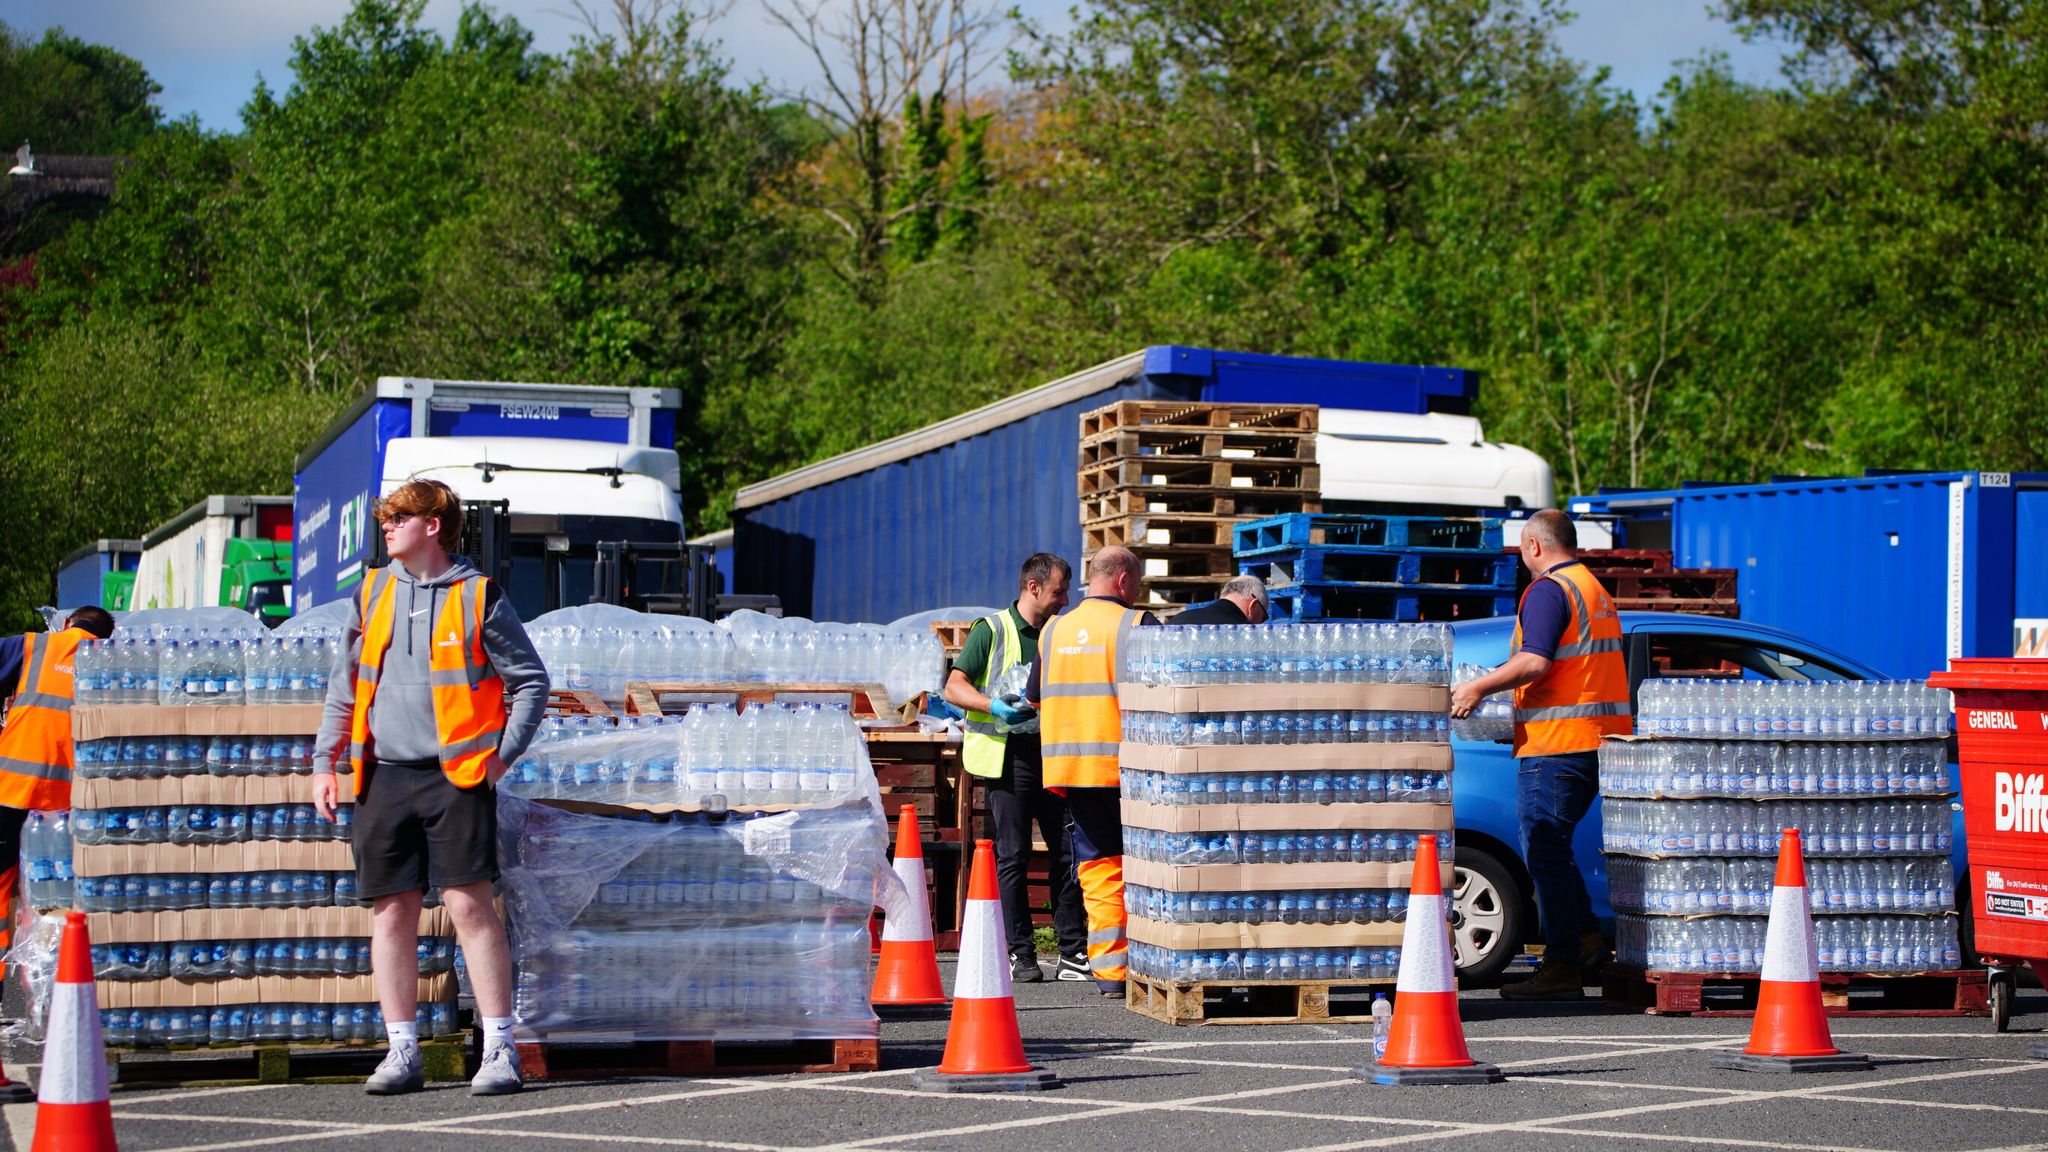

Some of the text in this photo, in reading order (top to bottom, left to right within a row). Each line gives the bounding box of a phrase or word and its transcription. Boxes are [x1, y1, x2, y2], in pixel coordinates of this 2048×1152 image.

[500, 404, 560, 421] FSEW2408
[1981, 474, 2009, 485] T124
[338, 489, 369, 563] FSEW
[1969, 710, 2018, 730] GENERAL
[1994, 897, 2024, 908] DO NOT ENTER
